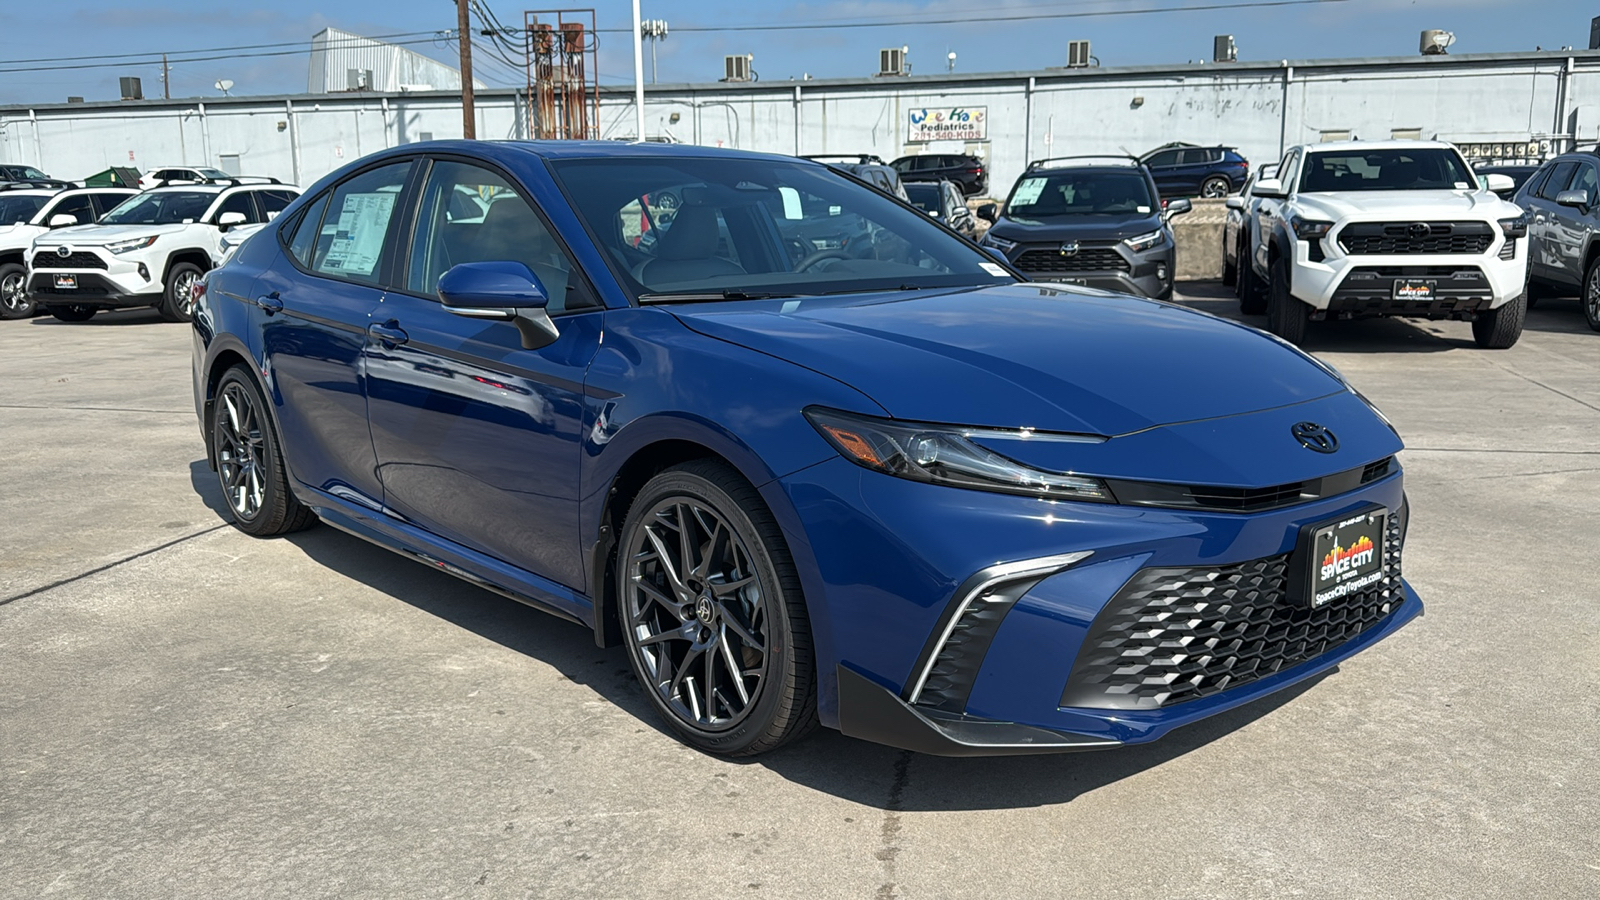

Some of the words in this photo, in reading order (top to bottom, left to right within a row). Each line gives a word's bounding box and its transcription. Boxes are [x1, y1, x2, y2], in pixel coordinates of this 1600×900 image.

[911, 108, 945, 124] Wee
[920, 123, 975, 131] Pediatrics
[1321, 557, 1350, 581] SPACE
[1351, 549, 1373, 568] CITY
[1316, 572, 1381, 605] SpaceCityToyota.com
